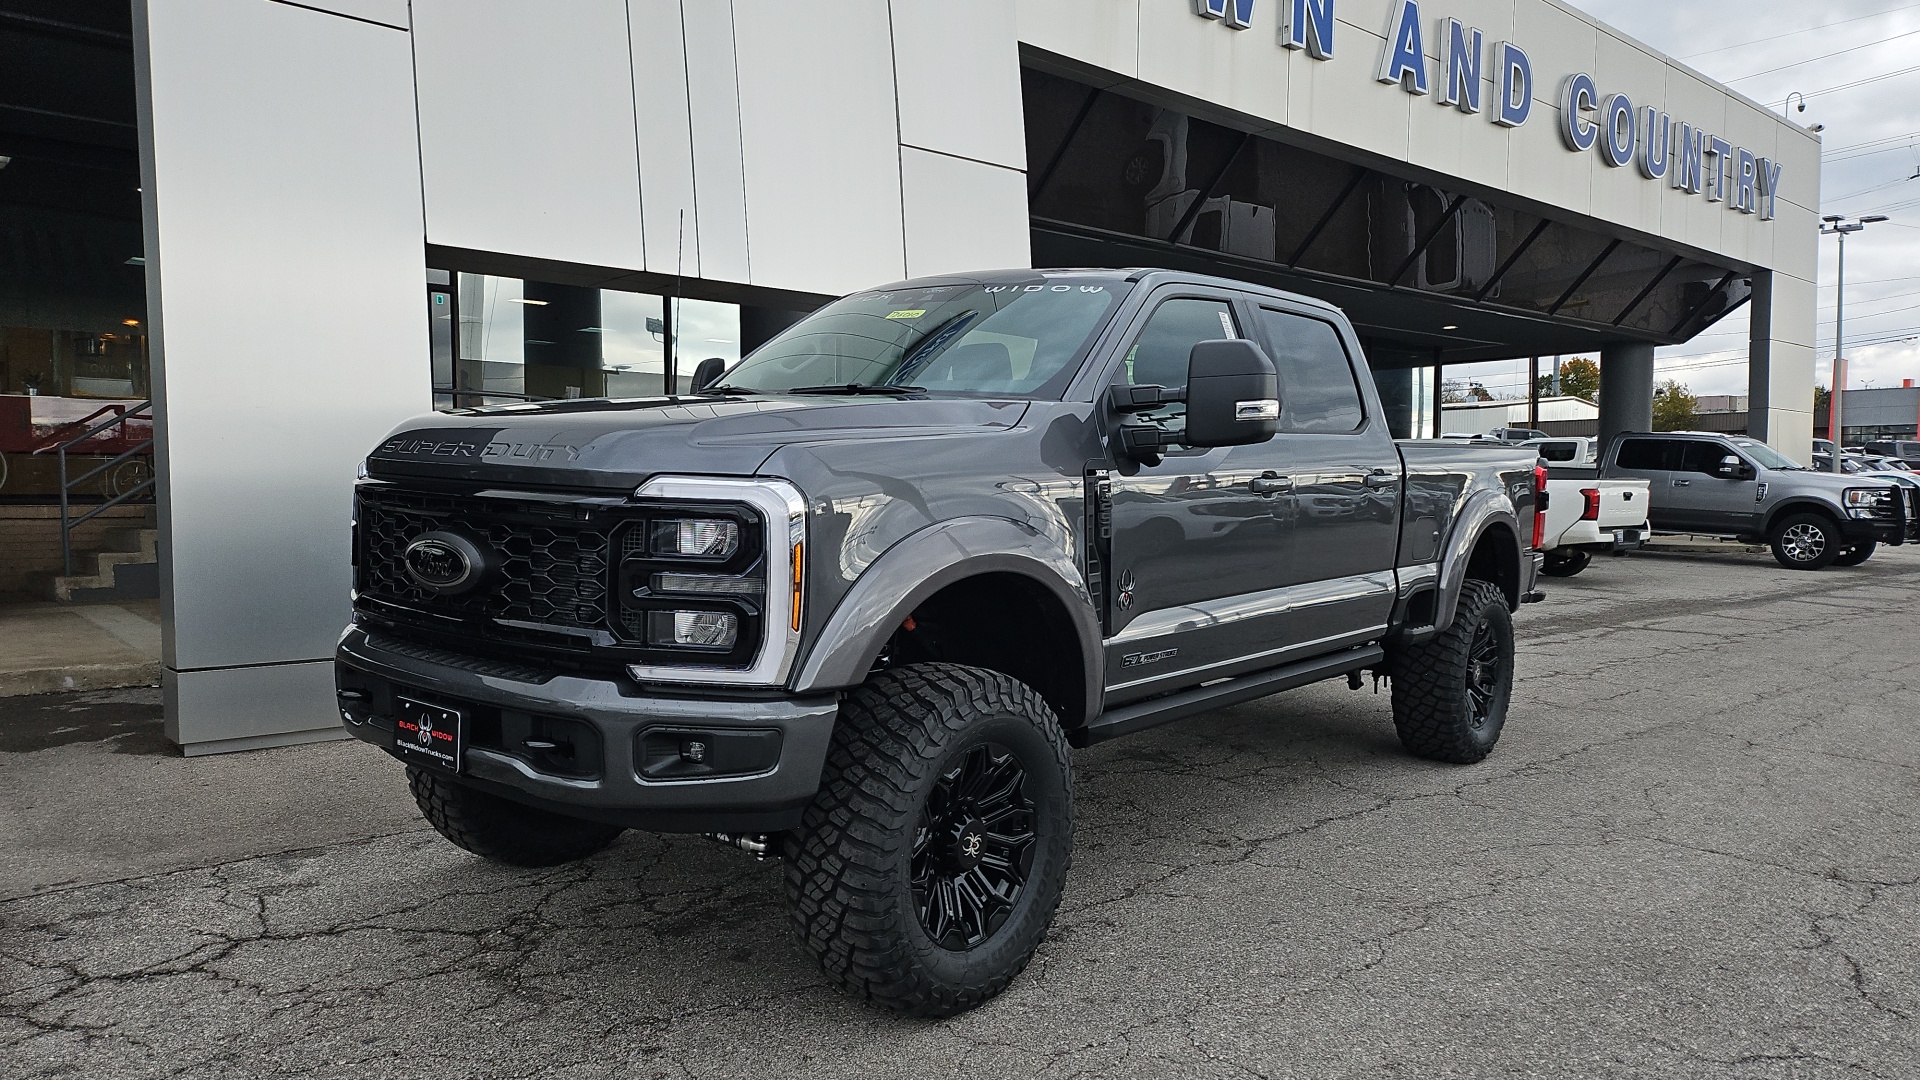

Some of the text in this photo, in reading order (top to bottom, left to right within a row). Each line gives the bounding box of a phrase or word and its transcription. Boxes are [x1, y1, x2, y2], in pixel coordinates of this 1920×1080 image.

[1378, 0, 1534, 128] AND
[1560, 72, 1783, 220] COUNTRY
[984, 285, 1104, 294] WIDOW
[381, 439, 596, 461] SUPER DUTY
[415, 545, 453, 577] Ford
[398, 720, 453, 742] BLACK WIDOW
[396, 739, 454, 762] BlackWidowTrucks.com
